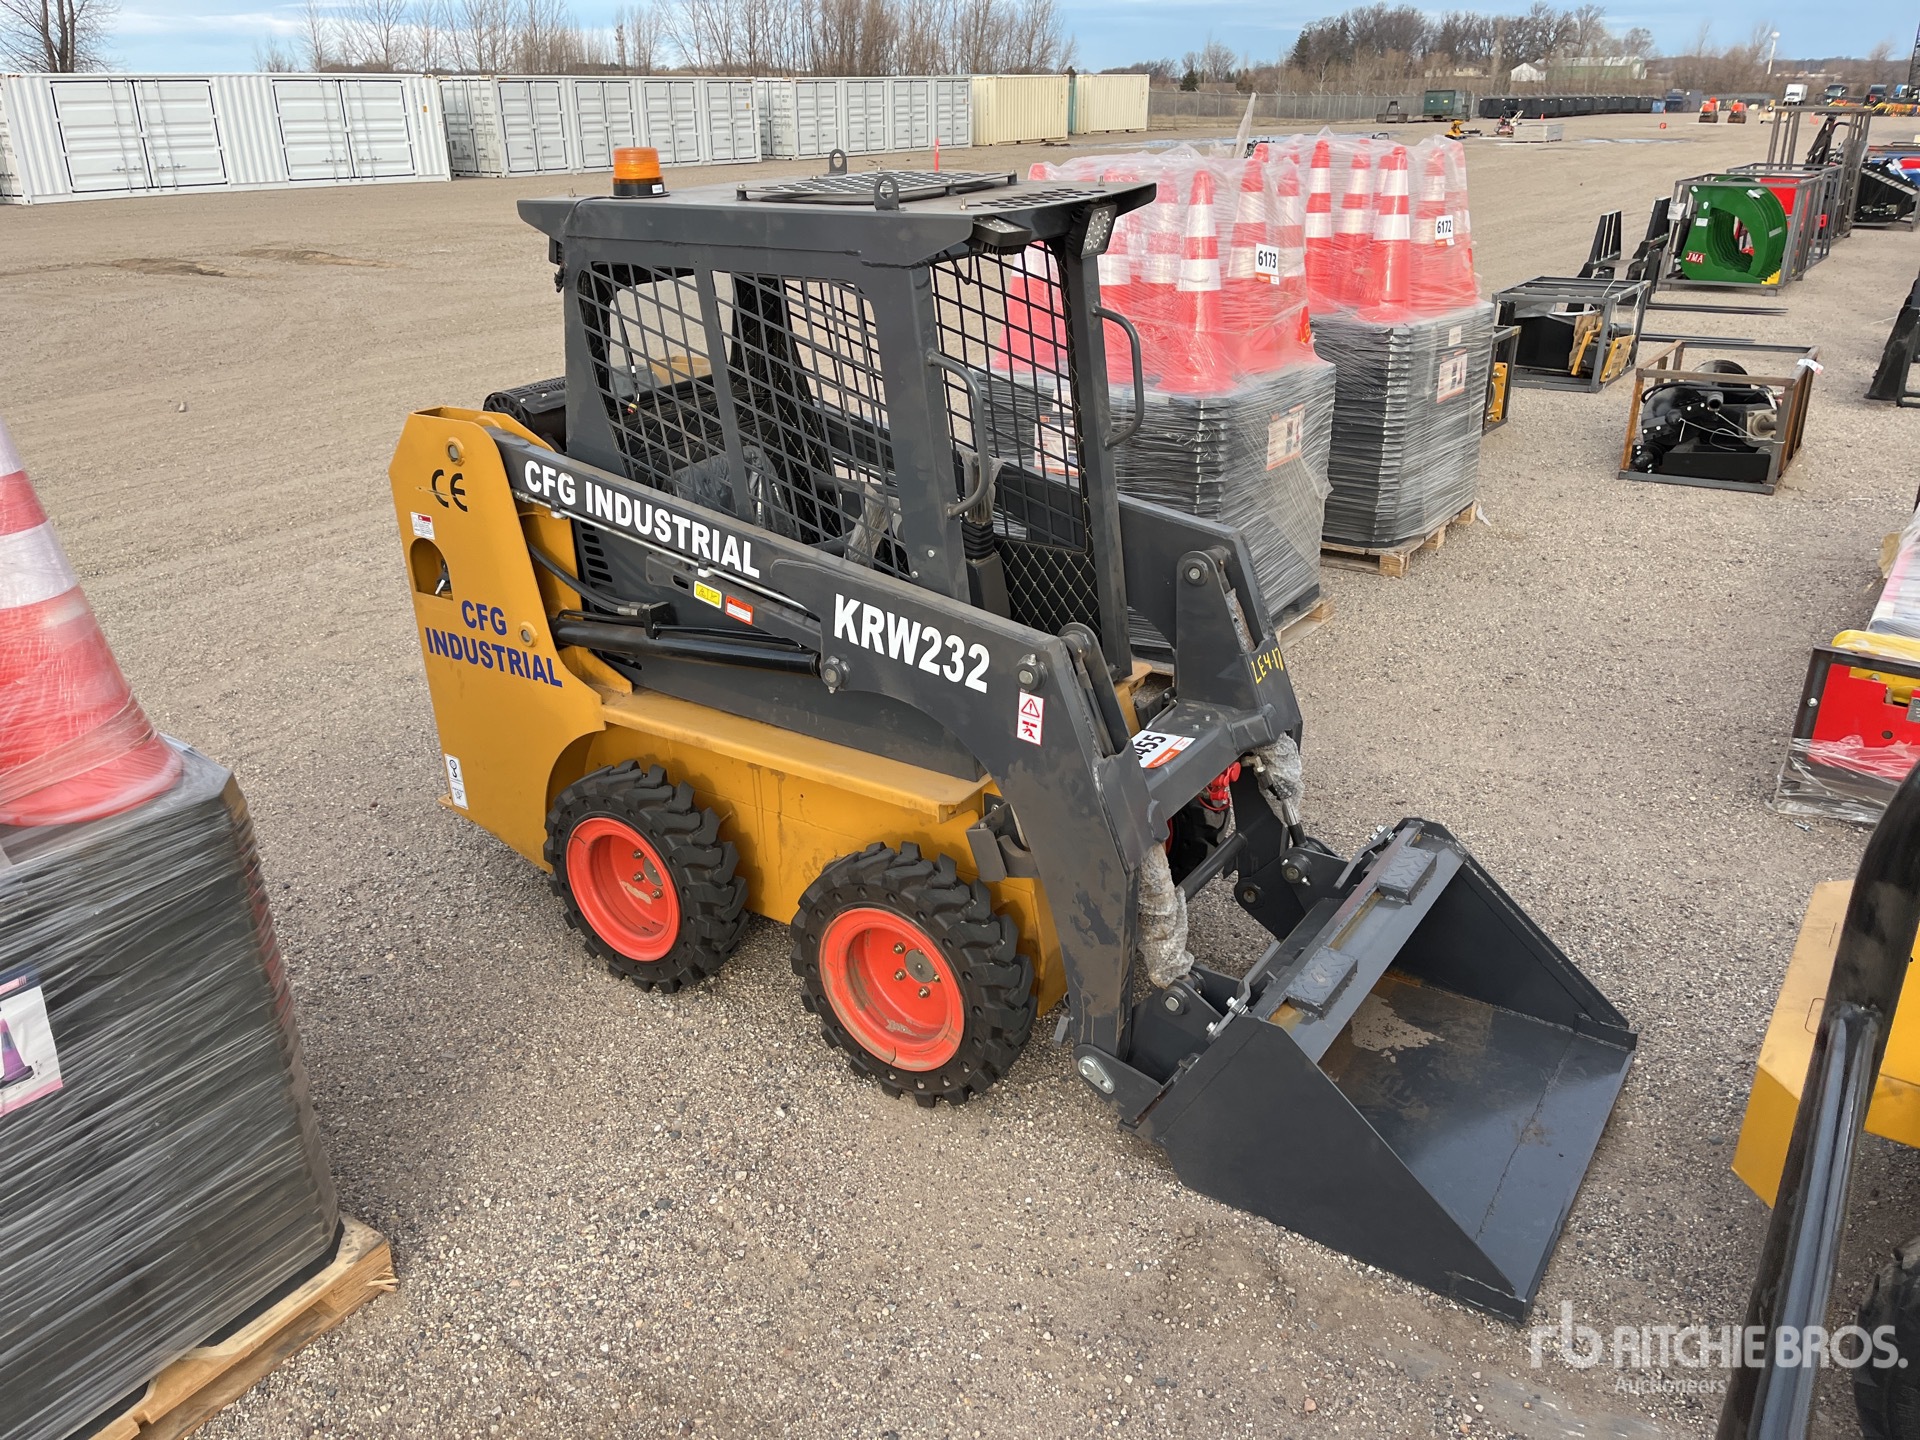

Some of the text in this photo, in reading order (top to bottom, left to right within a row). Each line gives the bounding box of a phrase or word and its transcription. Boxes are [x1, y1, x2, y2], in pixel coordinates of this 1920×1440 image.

[1436, 219, 1453, 234] 6172
[1257, 250, 1277, 269] 6173
[1685, 252, 1704, 264] JMA
[524, 459, 761, 579] CFG INDUSTRIAL
[461, 600, 508, 636] CFG
[424, 626, 563, 688] INDUSTRIAL
[833, 592, 991, 694] KRW232
[1134, 734, 1167, 760] 455
